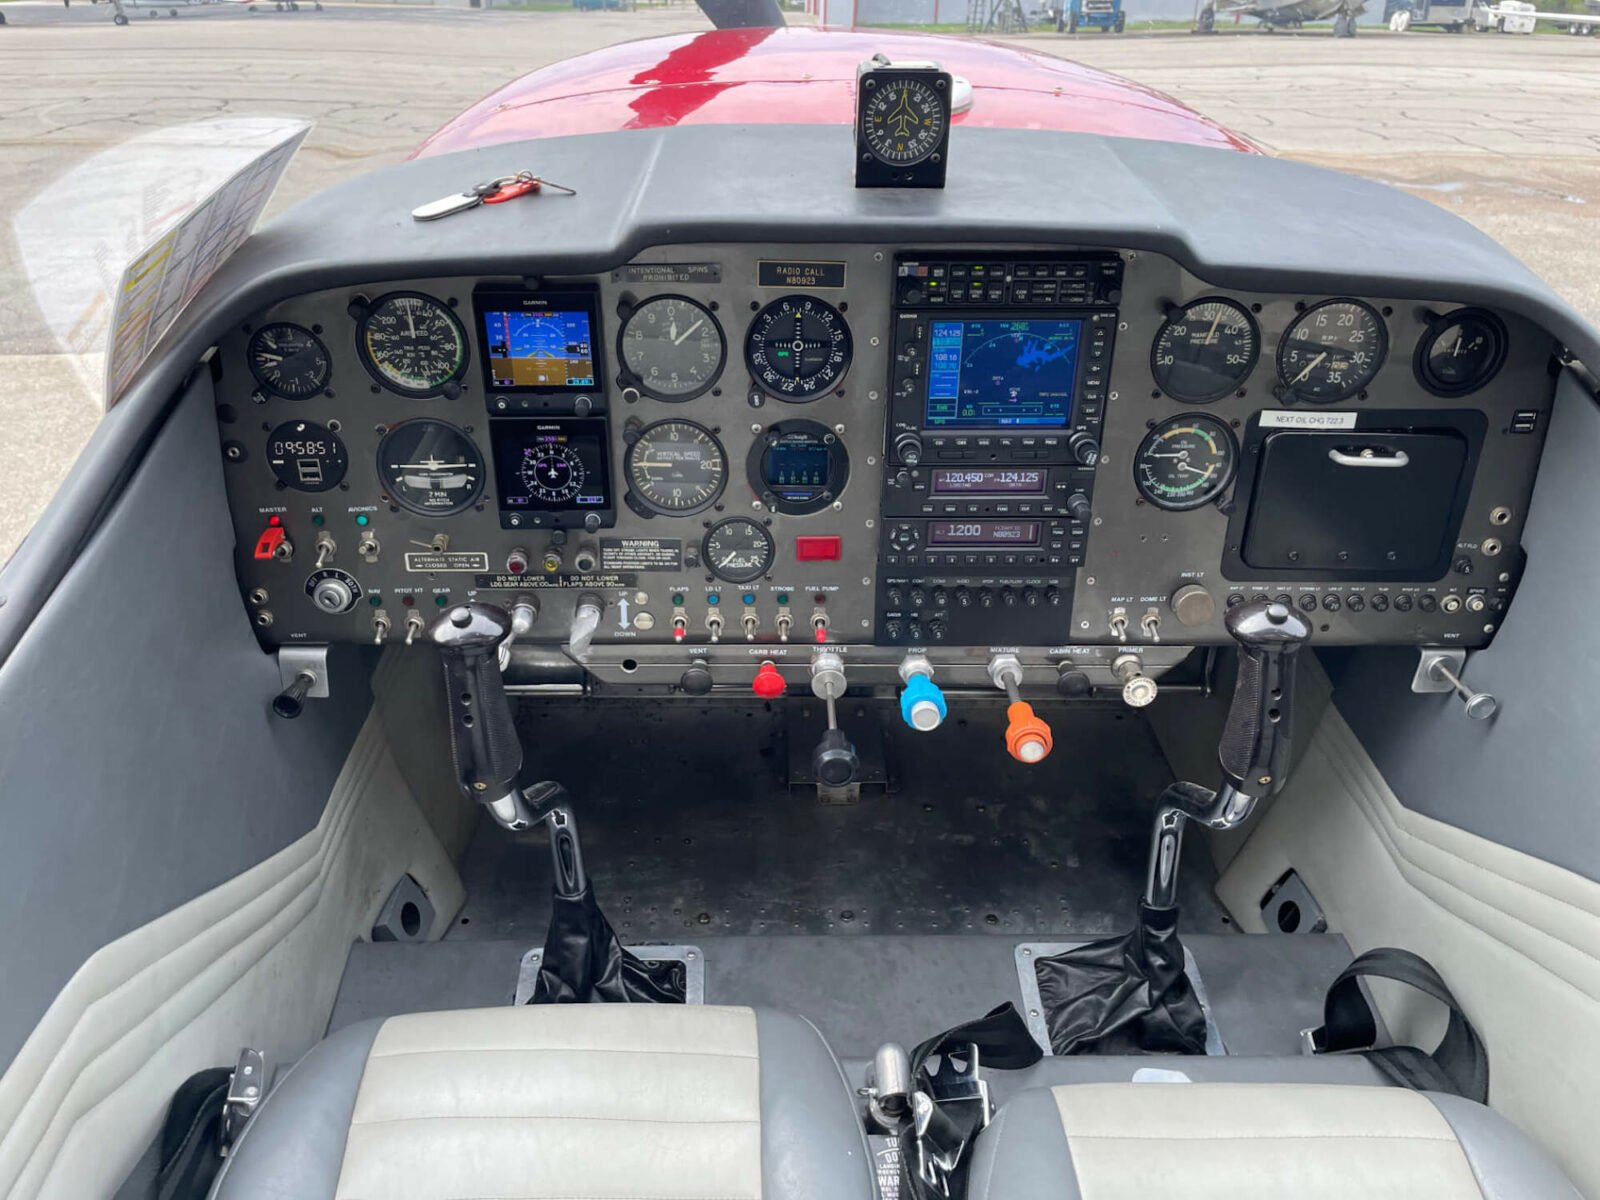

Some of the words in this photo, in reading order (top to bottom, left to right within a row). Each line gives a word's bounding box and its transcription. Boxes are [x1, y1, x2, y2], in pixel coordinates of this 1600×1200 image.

[777, 267, 800, 275] RADIO
[805, 268, 824, 276] CALL
[783, 303, 789, 311] 6
[805, 302, 811, 310] 9
[648, 313, 655, 323] 9
[822, 311, 833, 321] 12
[1202, 311, 1215, 321] 30
[1316, 314, 1328, 326] 15
[1337, 314, 1353, 326] 20
[702, 328, 709, 336] 2
[1173, 325, 1187, 336] 20
[1224, 325, 1238, 335] 40
[1296, 328, 1309, 340] 10
[636, 331, 643, 340] 8
[834, 330, 844, 341] 15
[1348, 330, 1365, 342] 25
[637, 352, 644, 360] 7
[703, 353, 709, 362] 3
[834, 352, 843, 362] 18
[1164, 355, 1174, 365] 10
[1226, 354, 1240, 364] 50
[1290, 351, 1298, 362] 5
[1349, 352, 1365, 363] 30
[651, 367, 658, 376] 6
[690, 366, 696, 374] 4
[822, 369, 834, 380] 21
[671, 373, 678, 382] 5
[1326, 372, 1341, 383] 35
[782, 382, 794, 391] 27
[804, 381, 815, 390] 24
[670, 432, 678, 440] 10
[700, 461, 712, 469] 20
[945, 472, 983, 482] 120.450
[1000, 472, 1039, 482] 124.125
[673, 488, 681, 497] 10
[726, 528, 732, 536] 10
[745, 528, 753, 536] 15
[947, 525, 981, 536] 1200
[345, 577, 358, 593] BOTH
[885, 1137, 899, 1147] TU
[885, 1152, 899, 1163] DO
